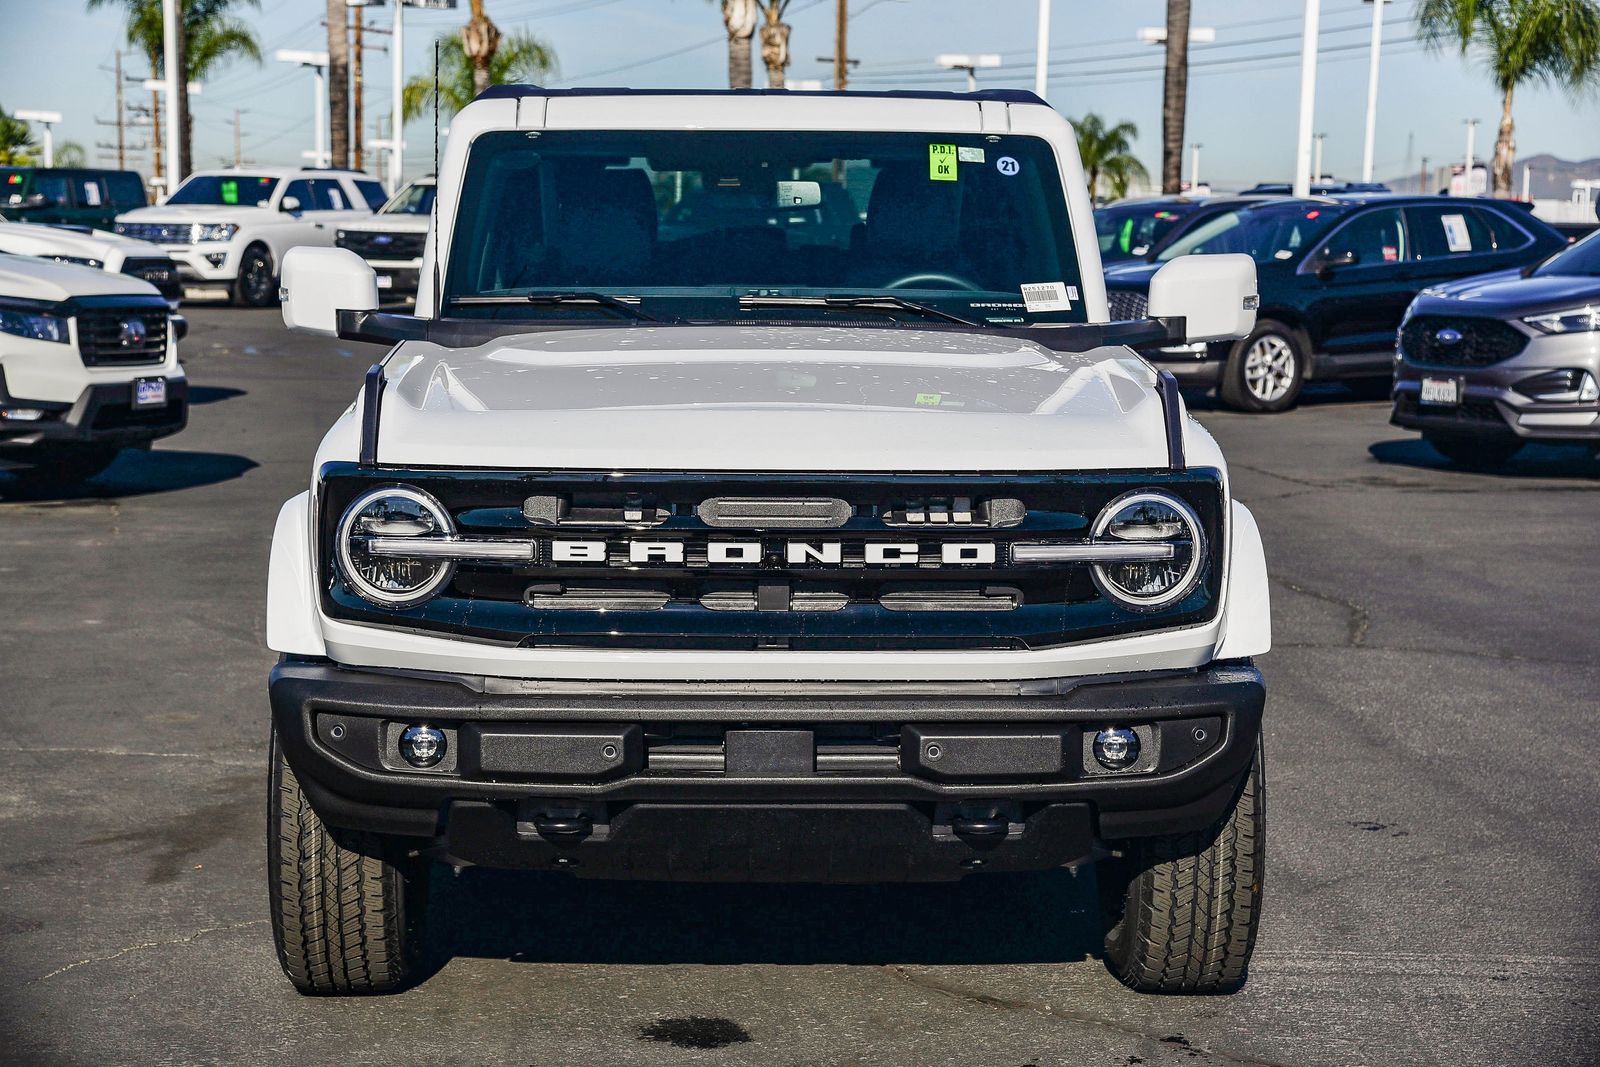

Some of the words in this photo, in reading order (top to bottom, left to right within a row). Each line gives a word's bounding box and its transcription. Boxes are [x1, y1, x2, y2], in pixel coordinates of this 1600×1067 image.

[932, 145, 954, 155] P.D.I.
[937, 164, 950, 175] OK
[1001, 160, 1016, 172] 21
[551, 540, 996, 564] BRONCO
